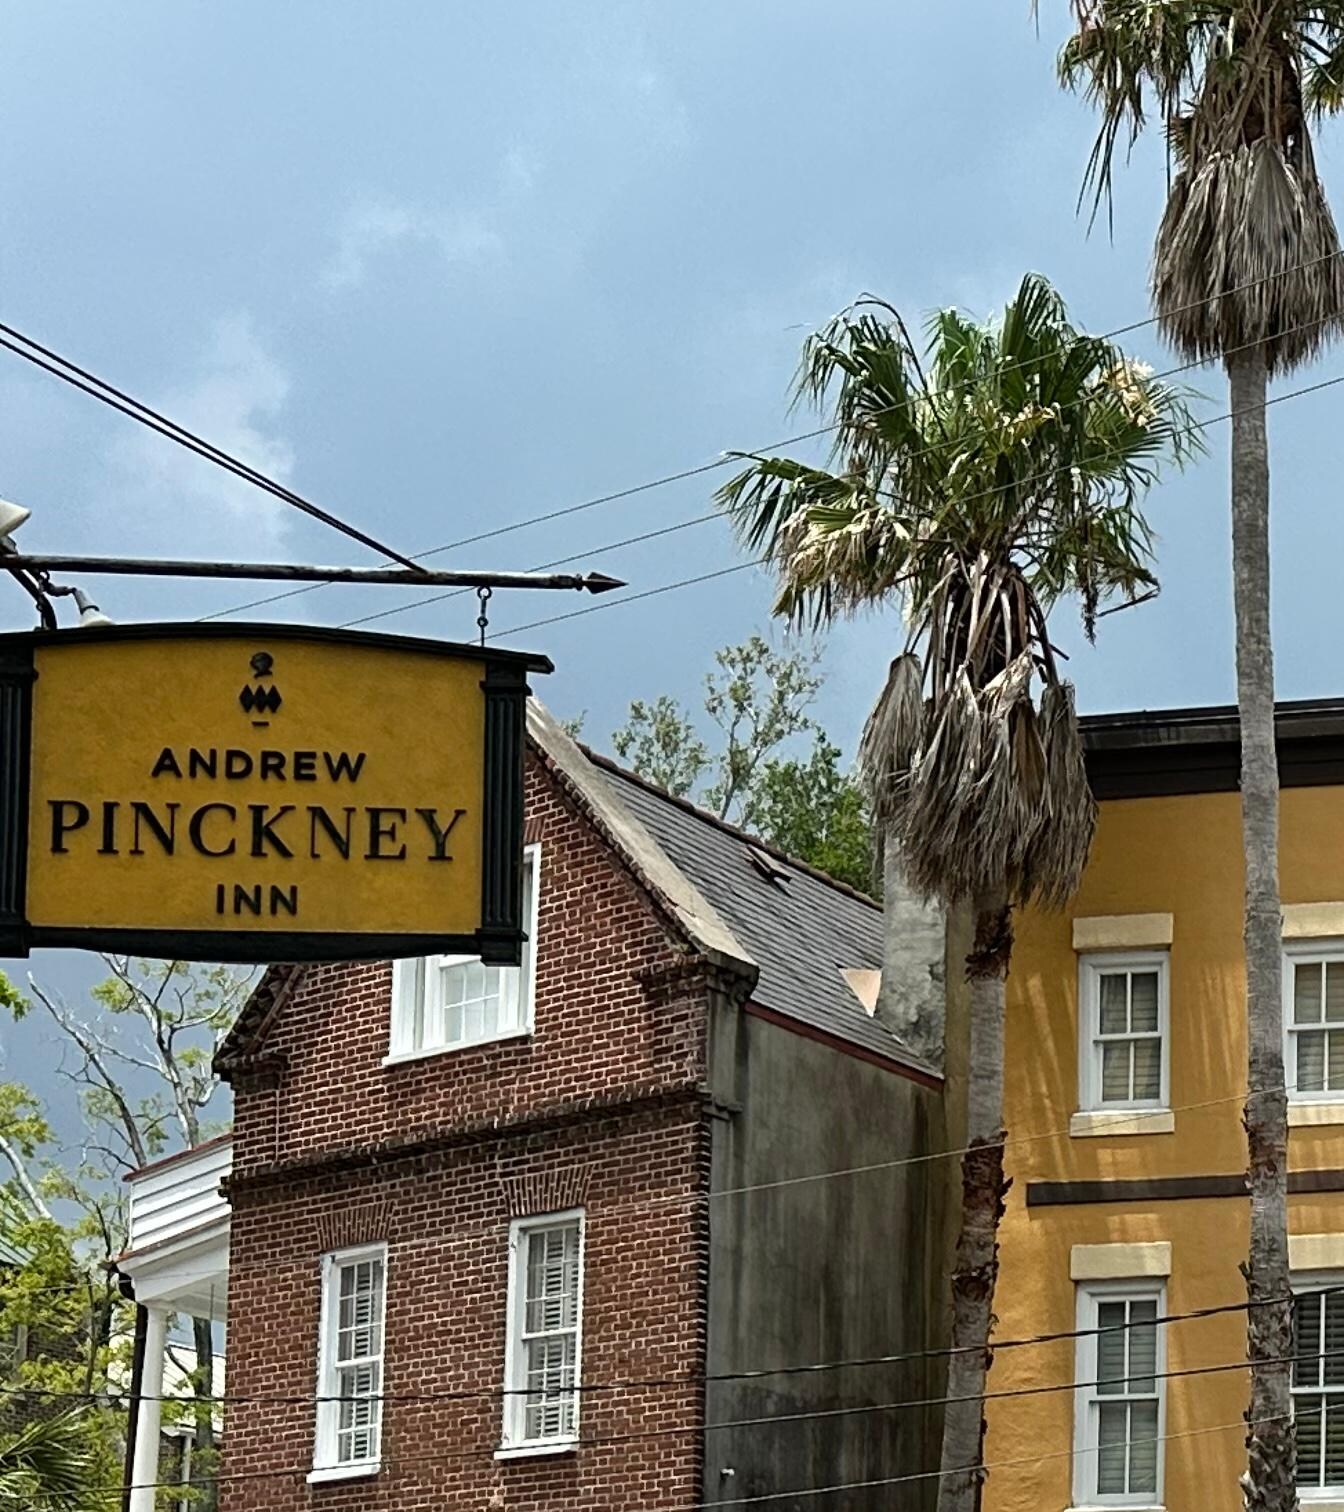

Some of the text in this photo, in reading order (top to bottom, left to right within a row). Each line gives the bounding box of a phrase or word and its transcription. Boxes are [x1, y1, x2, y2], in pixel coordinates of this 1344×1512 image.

[151, 747, 366, 783] ANDREW
[46, 799, 467, 862] PINCKNEY
[216, 884, 299, 916] INN
